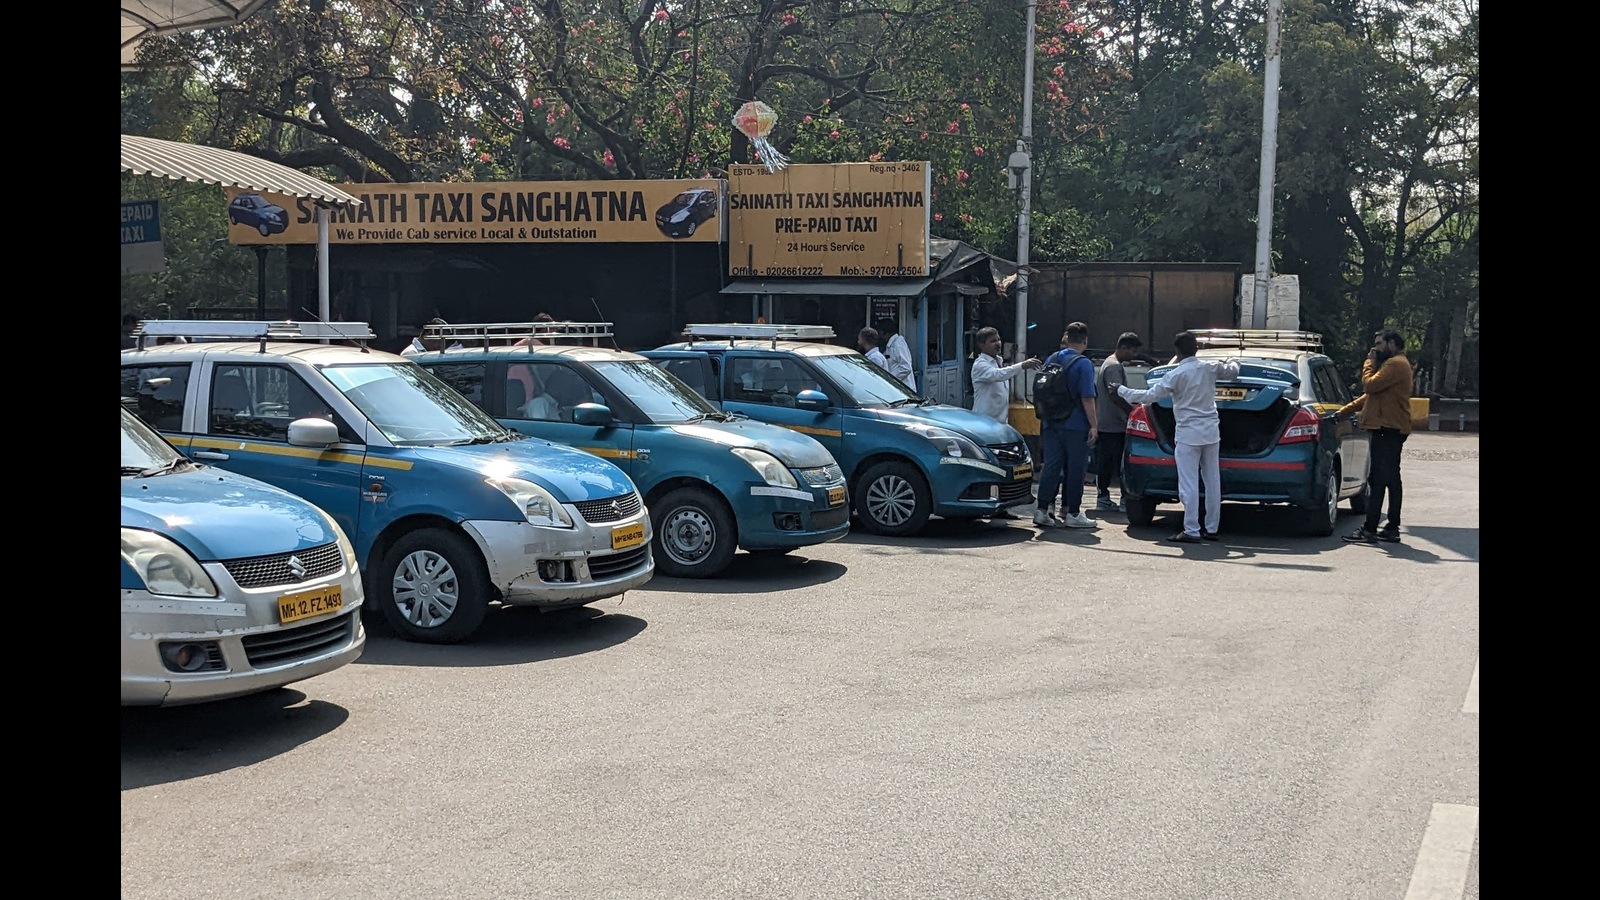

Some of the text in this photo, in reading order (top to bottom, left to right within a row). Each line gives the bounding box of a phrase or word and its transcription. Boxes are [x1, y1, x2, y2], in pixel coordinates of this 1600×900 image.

[902, 164, 921, 172] 3402
[414, 192, 474, 223] TAXI
[481, 190, 647, 223] SANGHATNA
[730, 191, 924, 210] SAINATH TAXI SANGHATNA
[775, 216, 877, 233] PRE-PAID TAXI
[336, 227, 597, 239] We Provide Cab service Local & Outstation
[787, 242, 865, 252] 24 Hours Service
[732, 267, 758, 276] Offie
[766, 266, 823, 276] 02026612222
[281, 592, 342, 619] MH.12.FZ.1493
